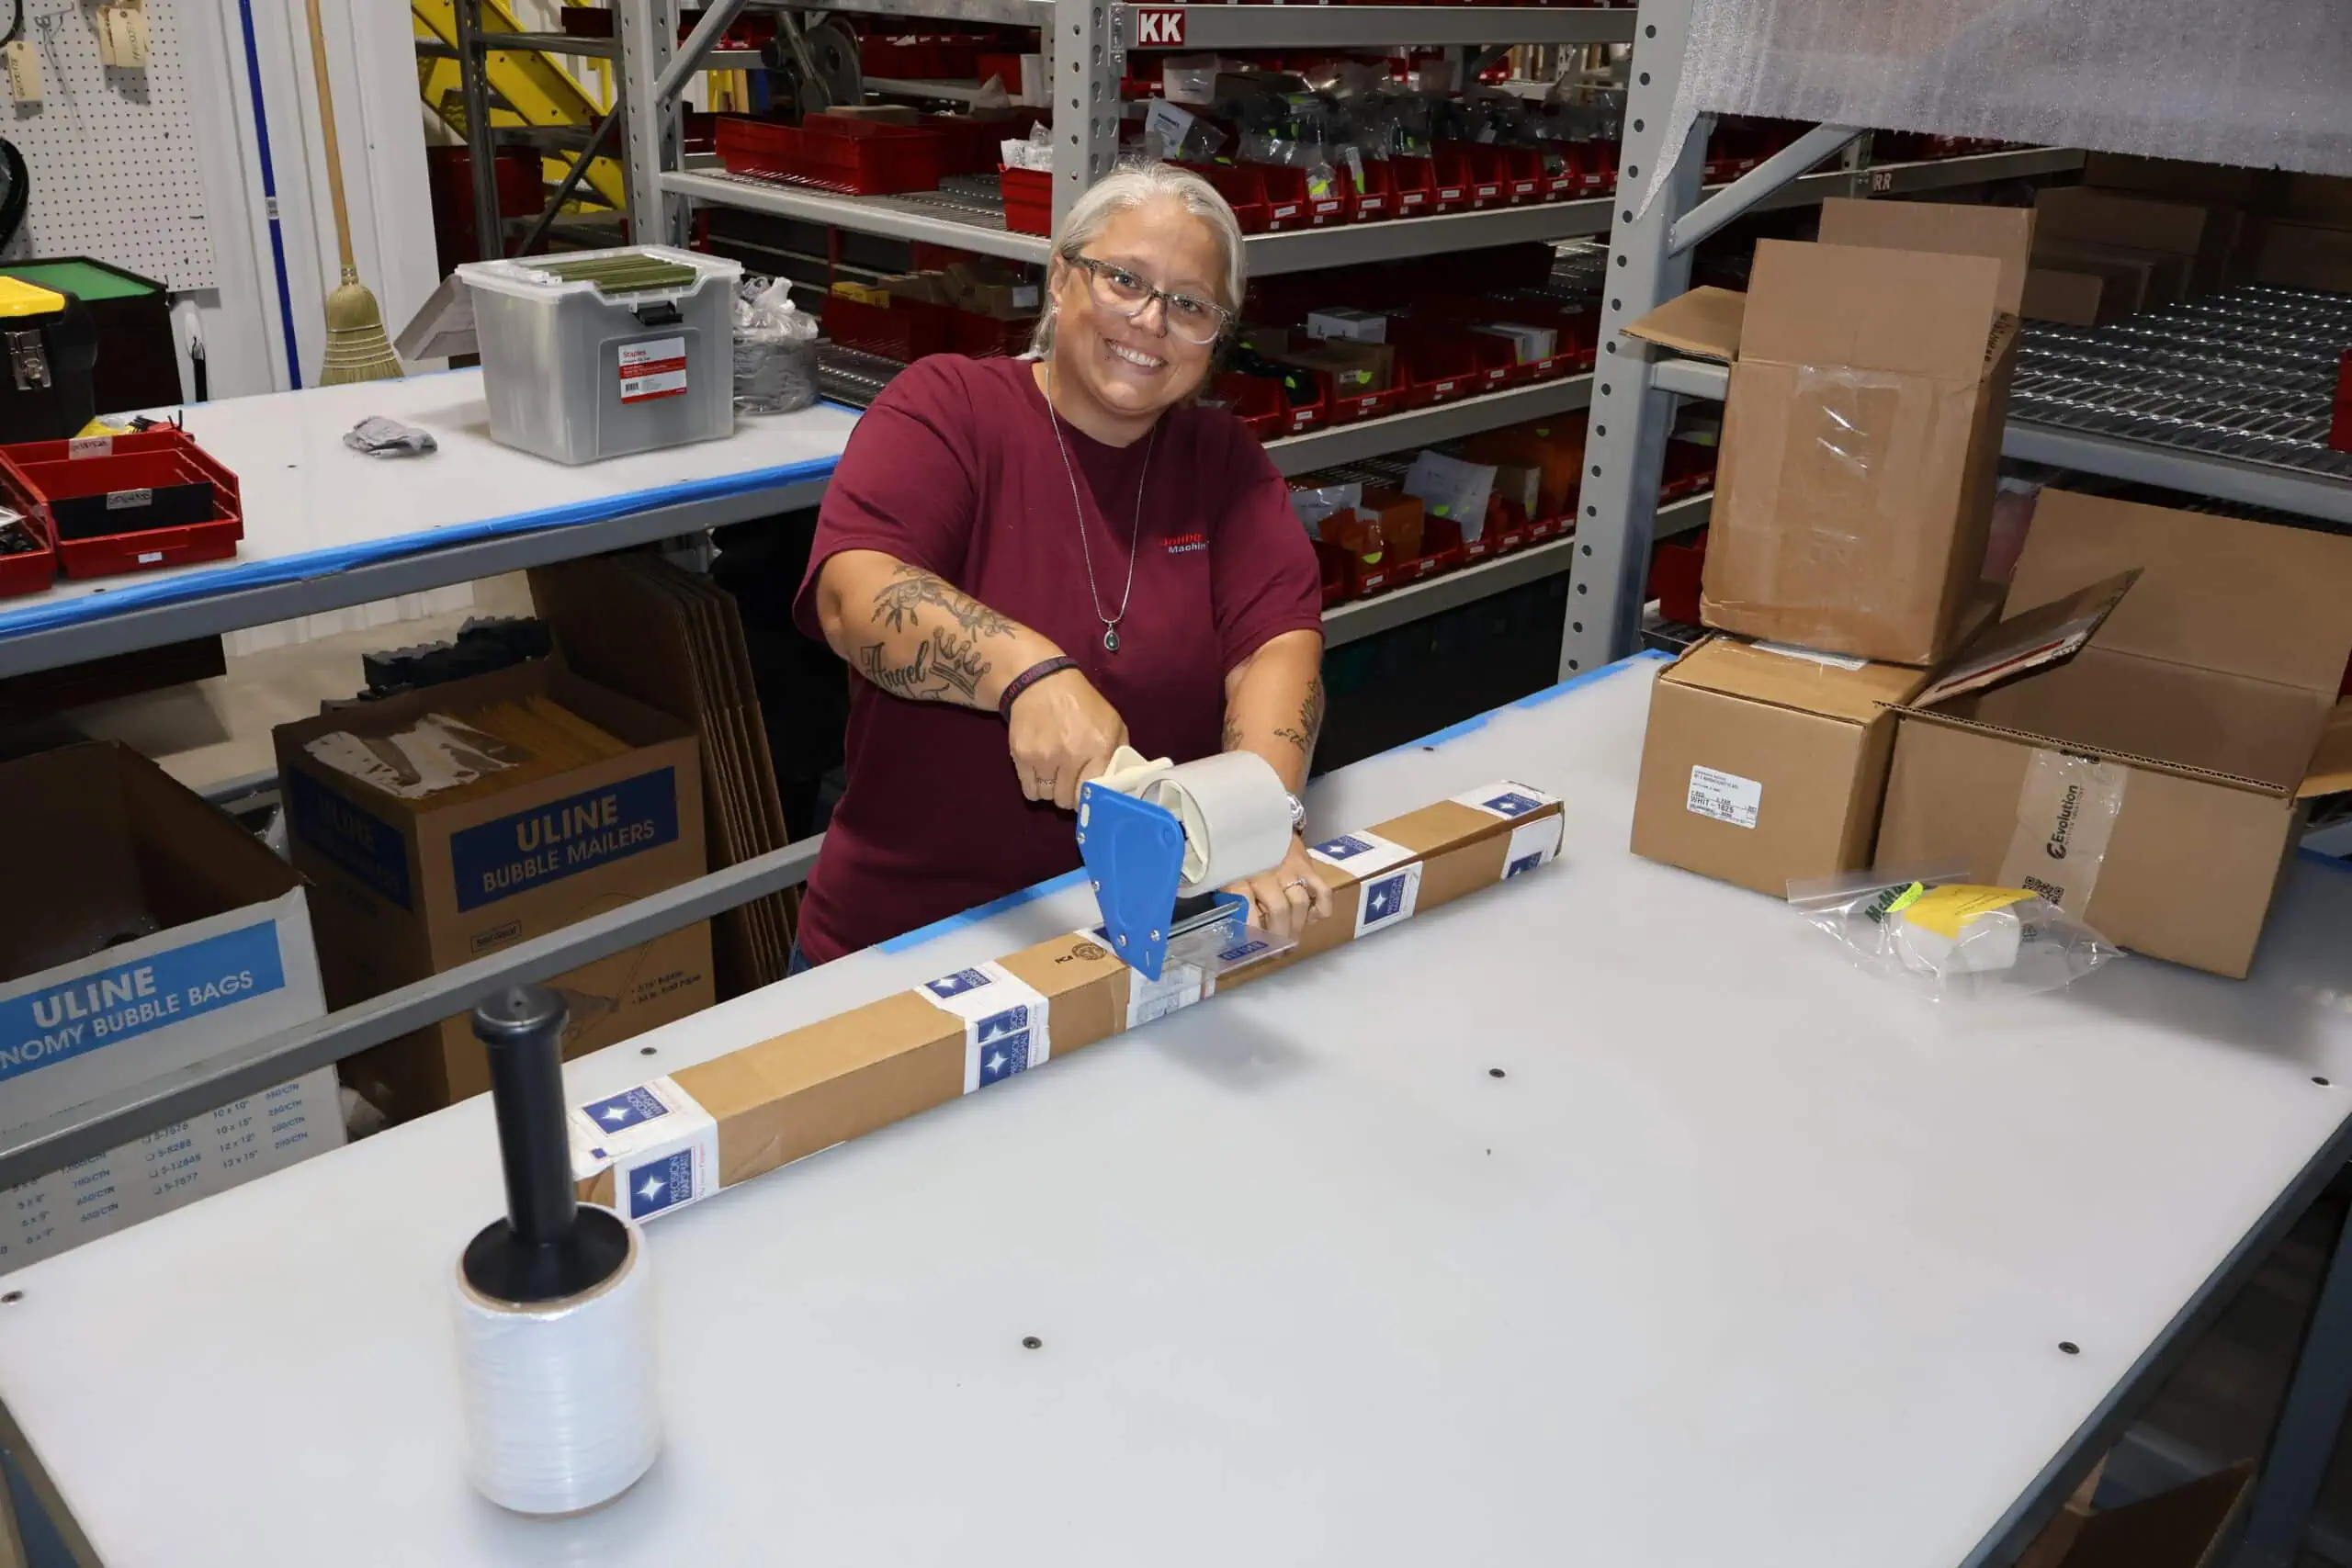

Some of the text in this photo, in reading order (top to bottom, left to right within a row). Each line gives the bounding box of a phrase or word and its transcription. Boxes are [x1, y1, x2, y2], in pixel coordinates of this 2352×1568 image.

[1140, 13, 1182, 42] KK
[1872, 173, 1893, 191] RR
[860, 639, 929, 698] Angel
[516, 795, 618, 852] ULINE
[2052, 784, 2079, 843] Evolution
[483, 819, 655, 893] BUBBLE MAILERS
[32, 966, 156, 1029] ULINE
[93, 993, 181, 1038] BUBBLE
[187, 970, 254, 1007] BAGS
